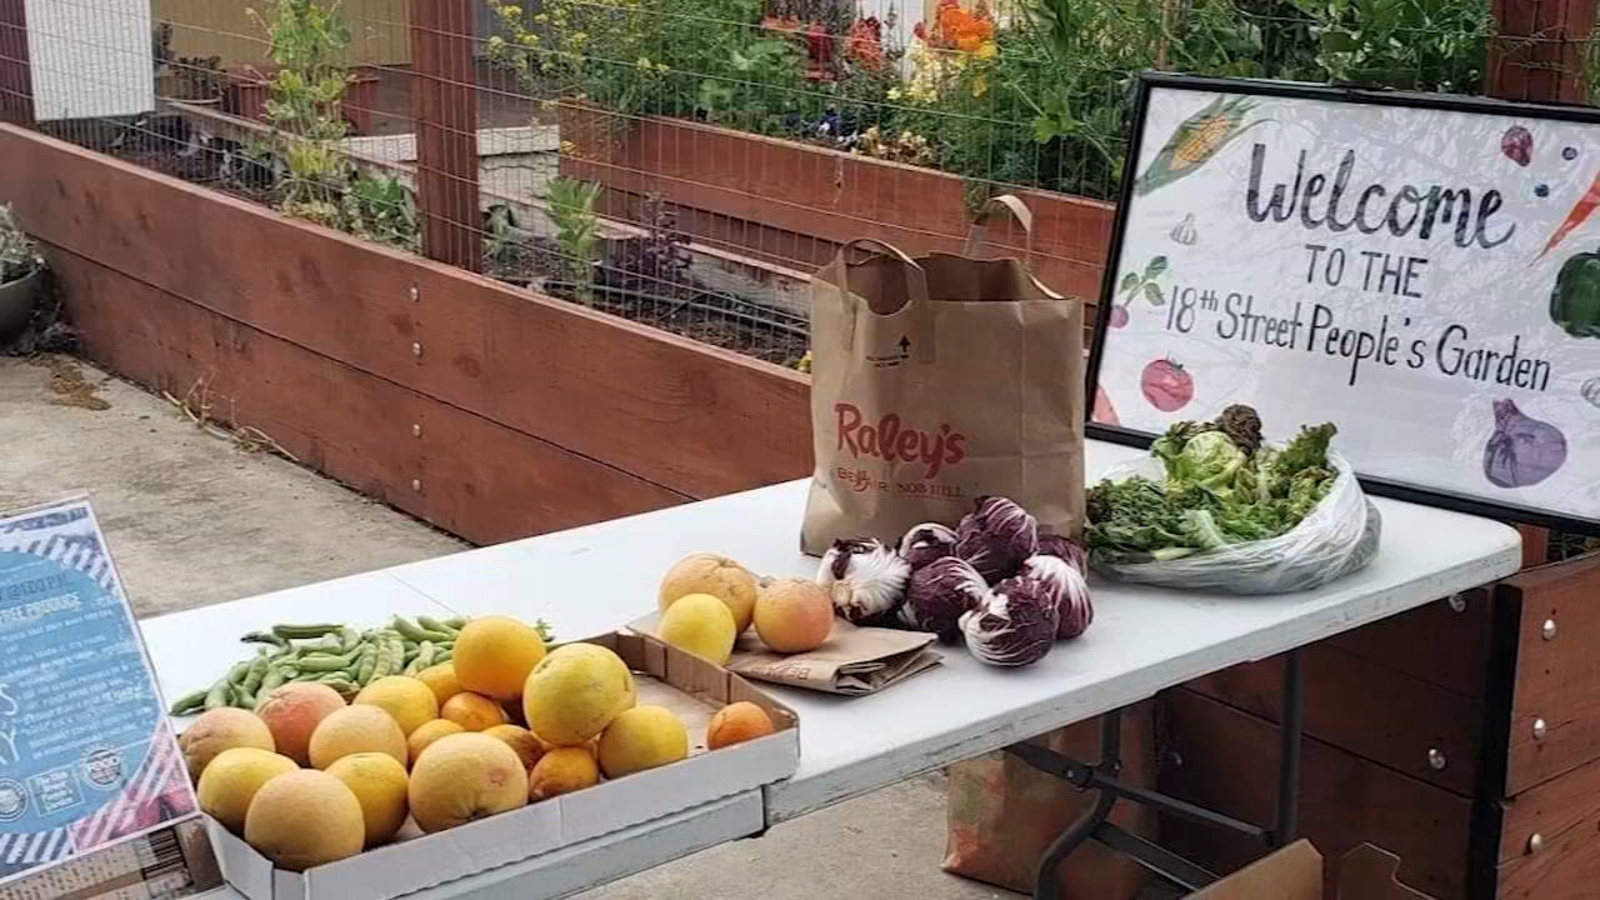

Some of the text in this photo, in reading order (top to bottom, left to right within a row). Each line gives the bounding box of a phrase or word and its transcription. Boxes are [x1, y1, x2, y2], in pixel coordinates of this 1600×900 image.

[1246, 143, 1516, 249] Welcome
[1305, 244, 1429, 298] TO THE
[1166, 286, 1551, 391] 18th Street People's Garden
[834, 402, 966, 480] Raley's
